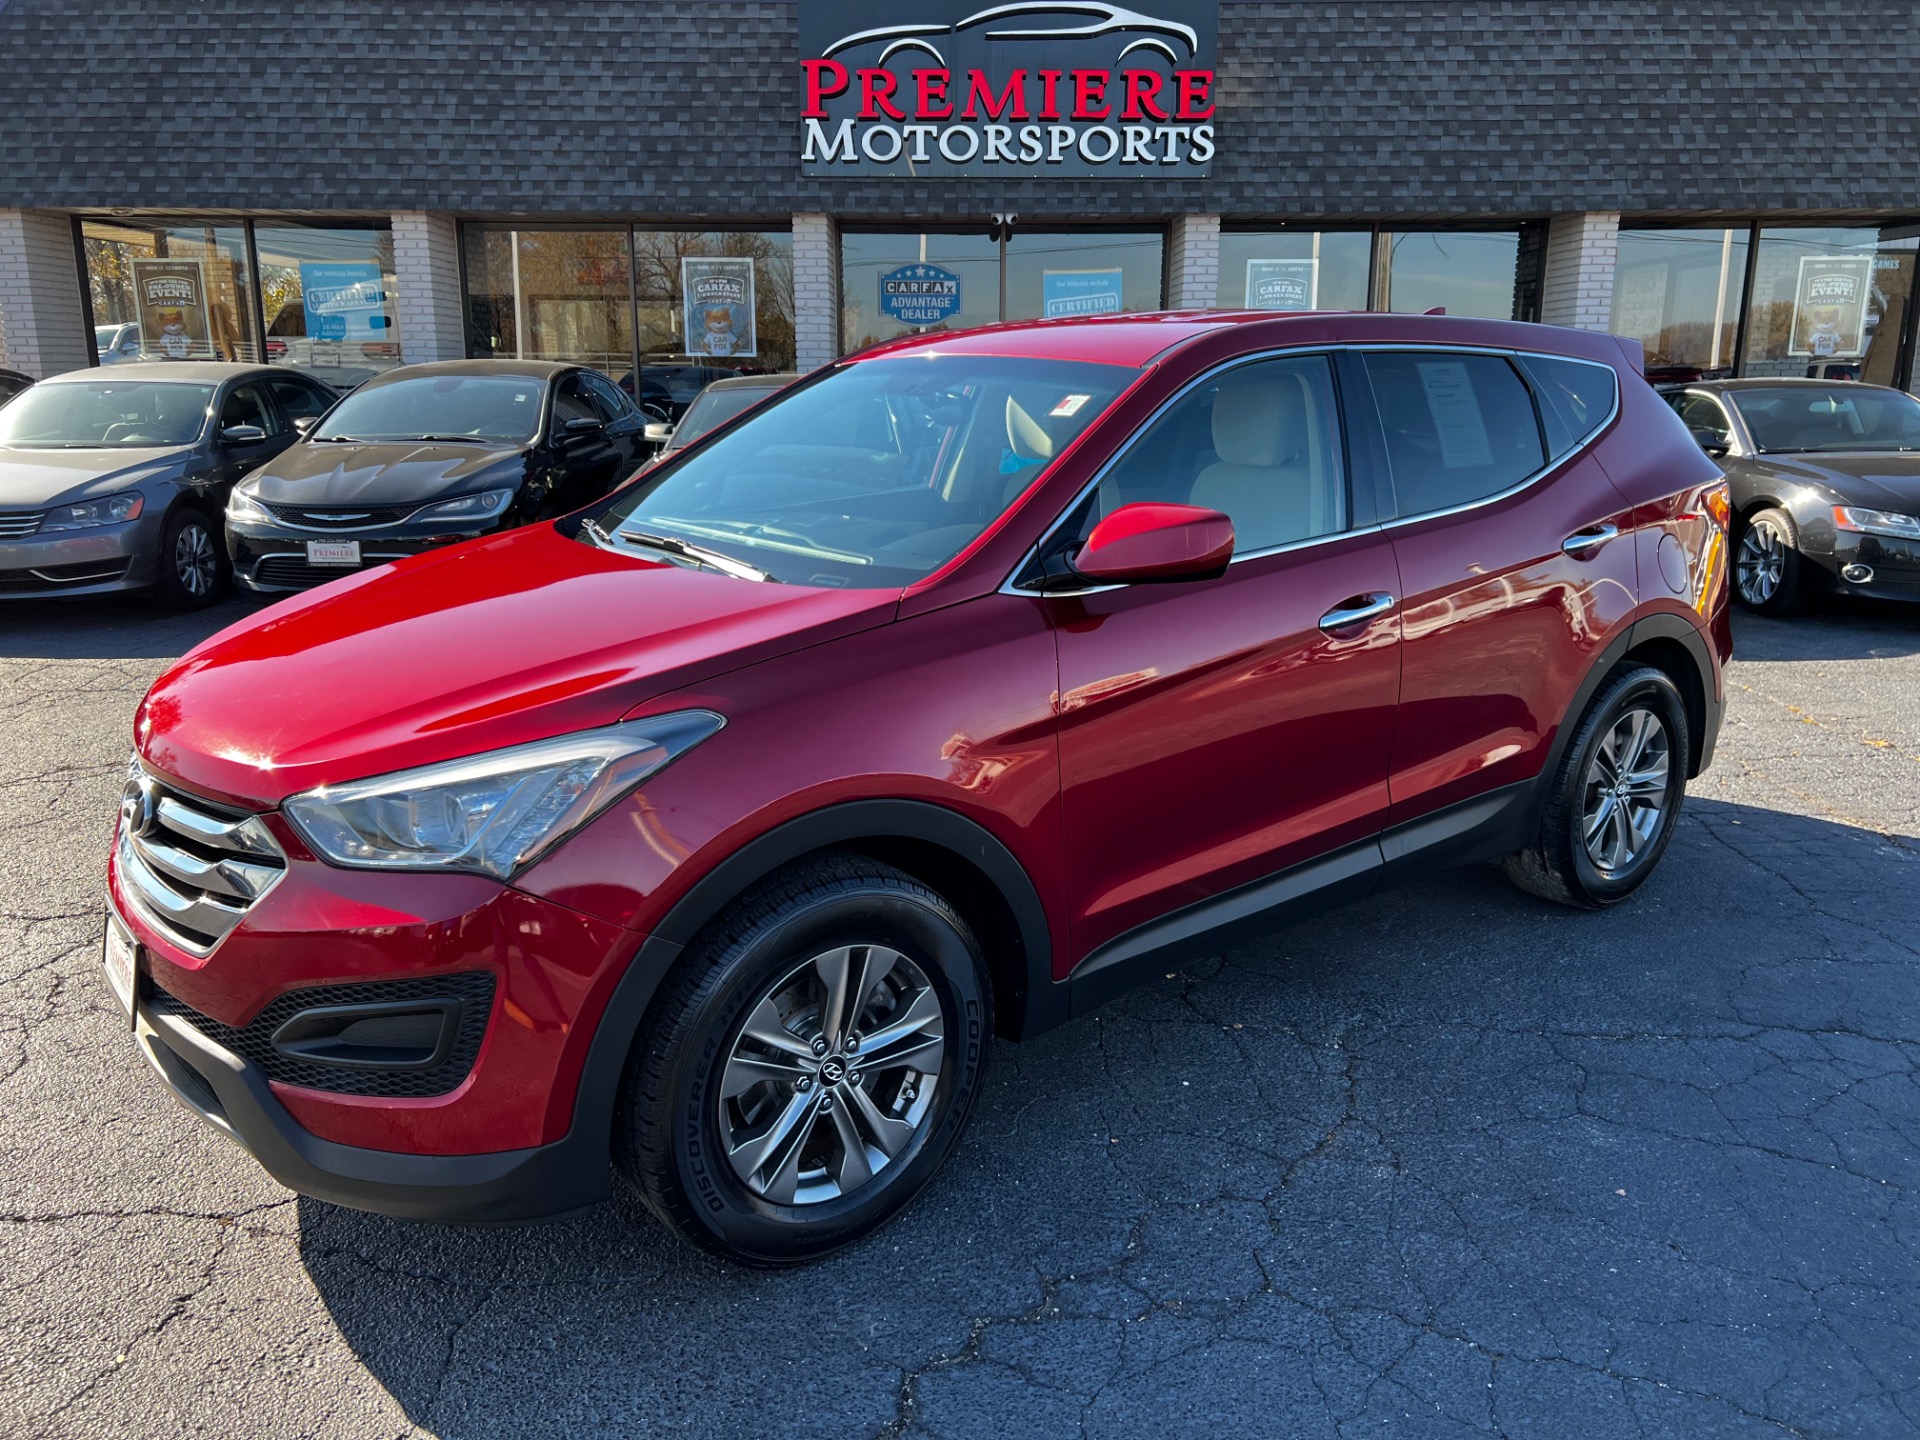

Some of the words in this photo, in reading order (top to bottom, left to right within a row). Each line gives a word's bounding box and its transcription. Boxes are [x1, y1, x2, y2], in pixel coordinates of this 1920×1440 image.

[800, 58, 1216, 121] PREMIERE
[800, 118, 1215, 164] MOTORSPORTS
[149, 289, 192, 298] EVENT!
[698, 284, 740, 293] CARFAX
[886, 282, 955, 294] CARFAX
[1260, 285, 1303, 294] CARFAX
[1811, 287, 1853, 296] EVENT!
[890, 297, 951, 308] ADVANTAGE
[1051, 296, 1115, 313] CERTIFIED
[901, 309, 940, 319] DEALER
[947, 999, 980, 1131] COOPER
[687, 1037, 724, 1214] DISCOVERER
